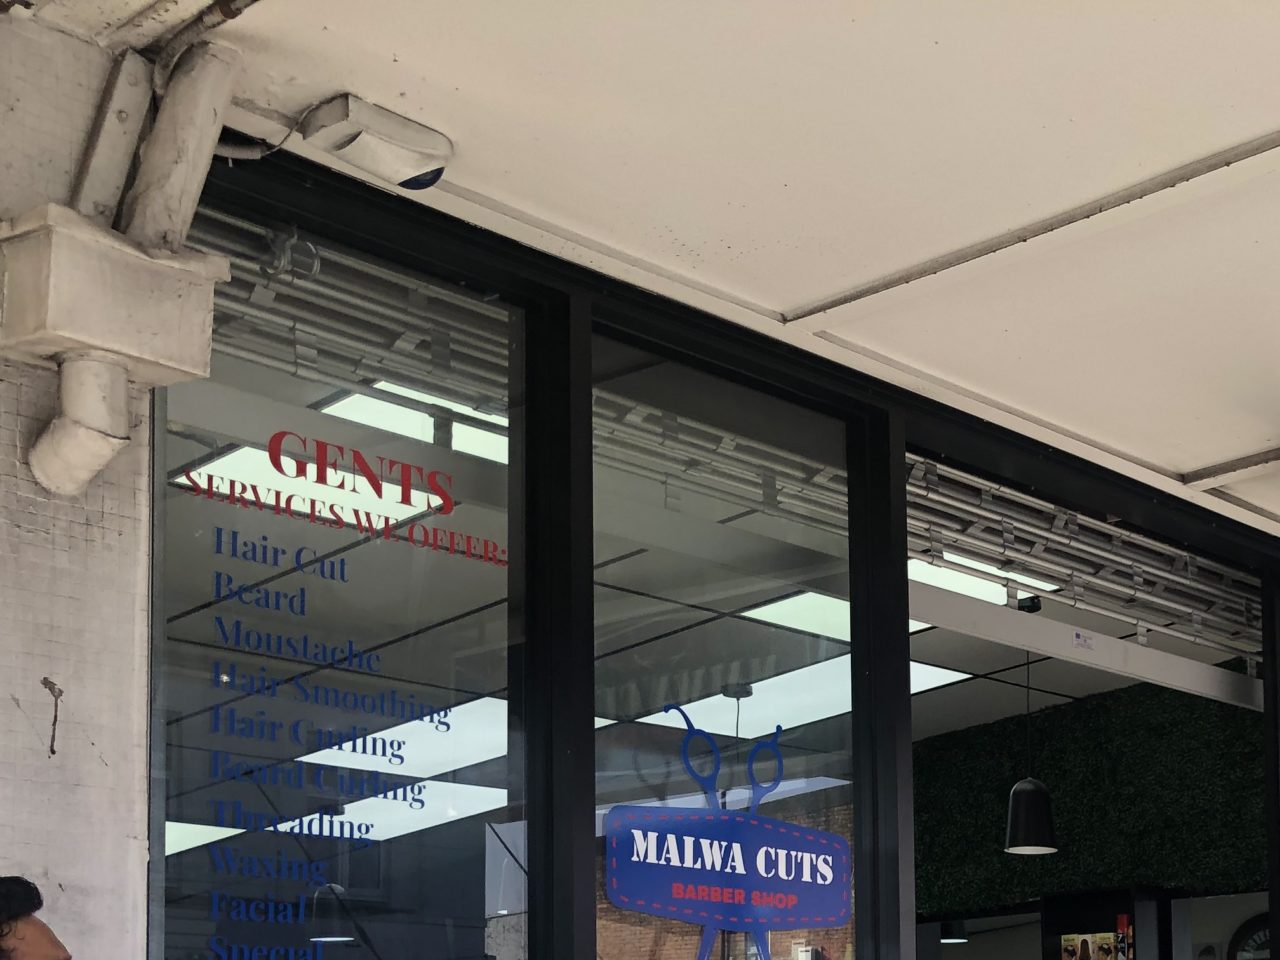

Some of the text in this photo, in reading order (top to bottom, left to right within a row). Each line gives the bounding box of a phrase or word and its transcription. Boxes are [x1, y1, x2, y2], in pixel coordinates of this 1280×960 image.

[268, 430, 454, 514] GENTS
[184, 470, 345, 529] SERVICES
[353, 507, 402, 542] WE
[214, 526, 350, 583] Hair Cut
[214, 571, 307, 617] Beard
[214, 615, 382, 674] Moustache
[211, 660, 452, 733] Hair Smoothing
[209, 703, 406, 765] Hair Curling
[209, 751, 427, 809] Beard Curling
[209, 800, 374, 848] Threading
[209, 846, 331, 889] Waxing
[631, 829, 834, 886] MALWA CUTS
[210, 891, 308, 926] Facial
[672, 883, 798, 909] BARBER SHOP
